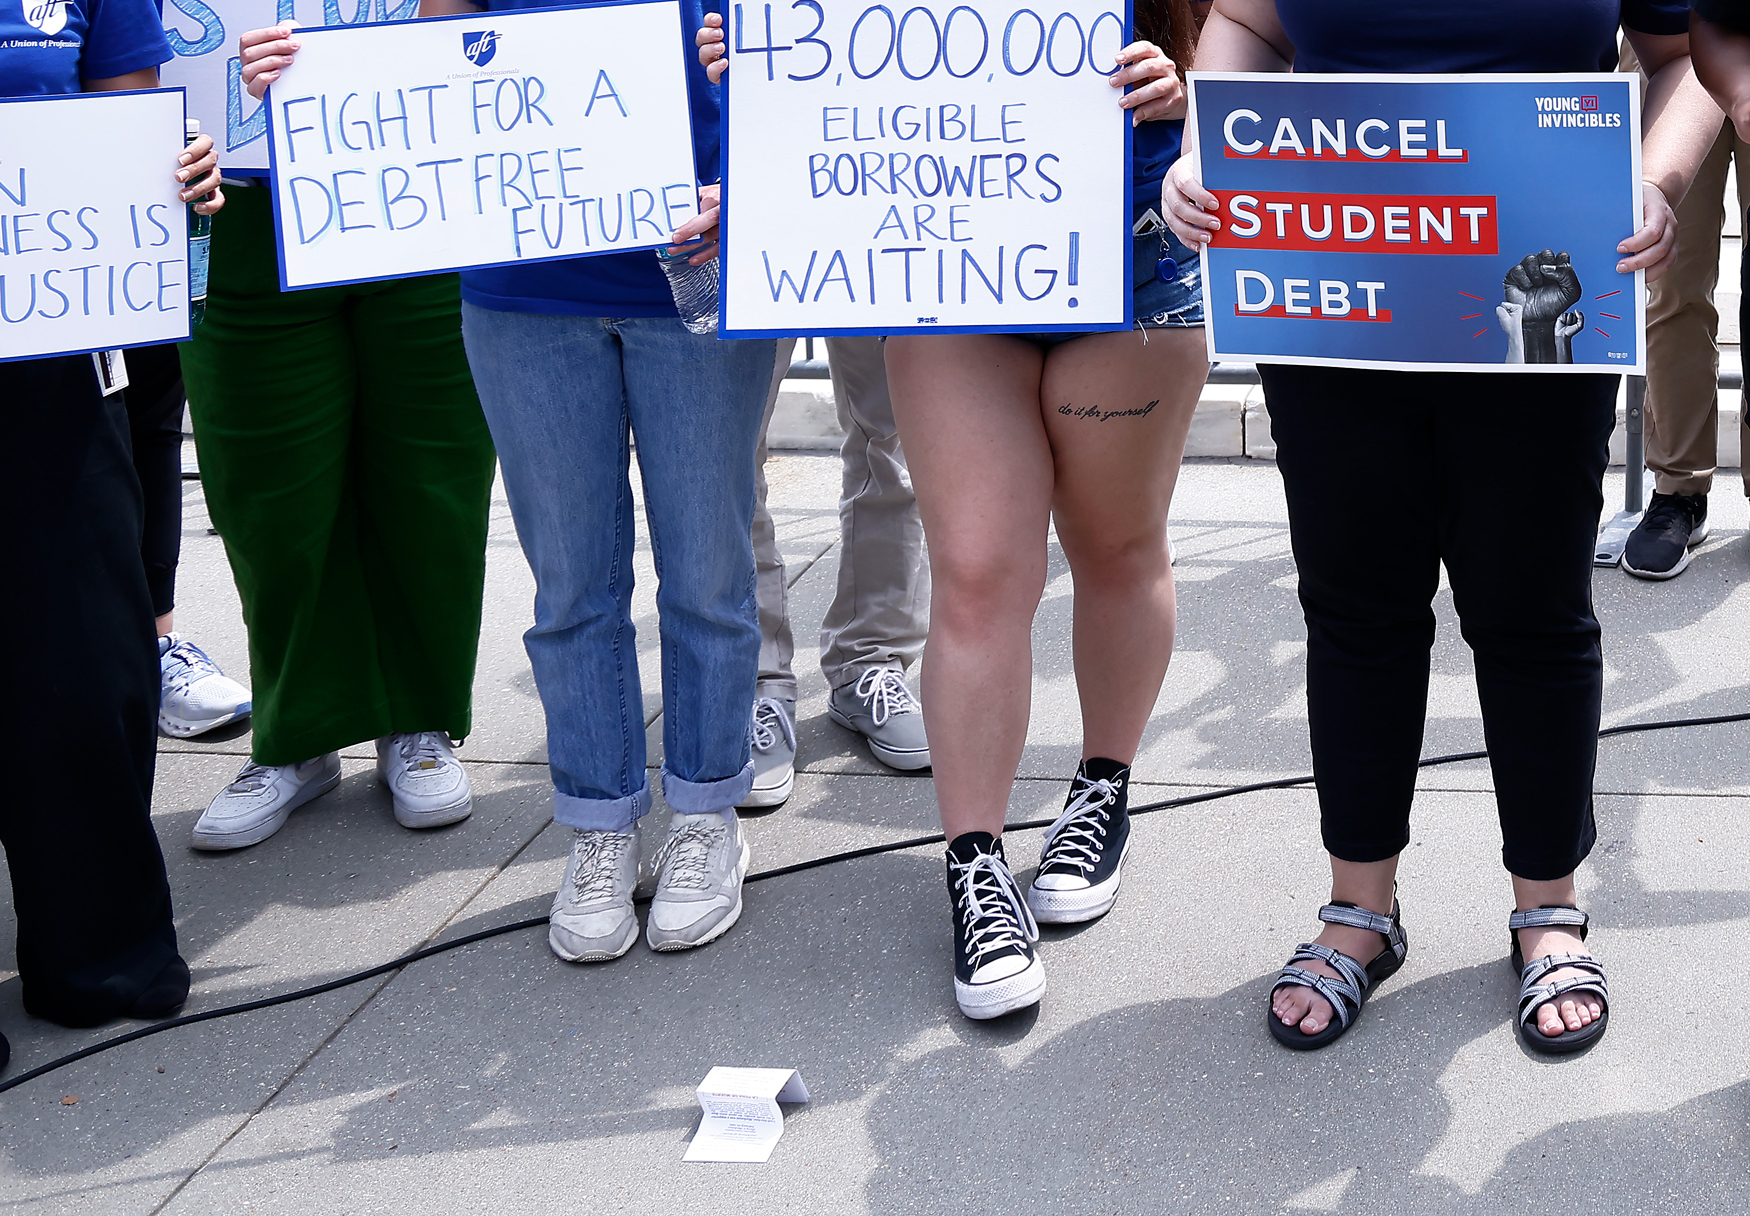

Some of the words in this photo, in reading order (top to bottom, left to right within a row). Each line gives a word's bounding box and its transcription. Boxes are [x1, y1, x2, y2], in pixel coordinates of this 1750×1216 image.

[0, 40, 8, 48] A
[10, 40, 38, 48] Union
[38, 40, 48, 49] of
[465, 30, 503, 64] aft
[734, 0, 1124, 86] 43,000,000
[283, 83, 450, 162] FIGHT
[471, 75, 554, 135] FOR
[584, 69, 628, 118] A
[823, 103, 1027, 143] ELIGIBLE
[1535, 97, 1580, 112] YOUNG
[1538, 113, 1622, 128] INVINCIBLES
[289, 157, 463, 246] DEBT
[473, 147, 584, 215] FREE
[808, 151, 1062, 203] BORROWERS
[129, 204, 171, 250] IS
[511, 183, 692, 258] FUTURE
[873, 204, 973, 242] ARE
[762, 231, 1080, 309] WAITING!
[1100, 399, 1160, 422] yourself
